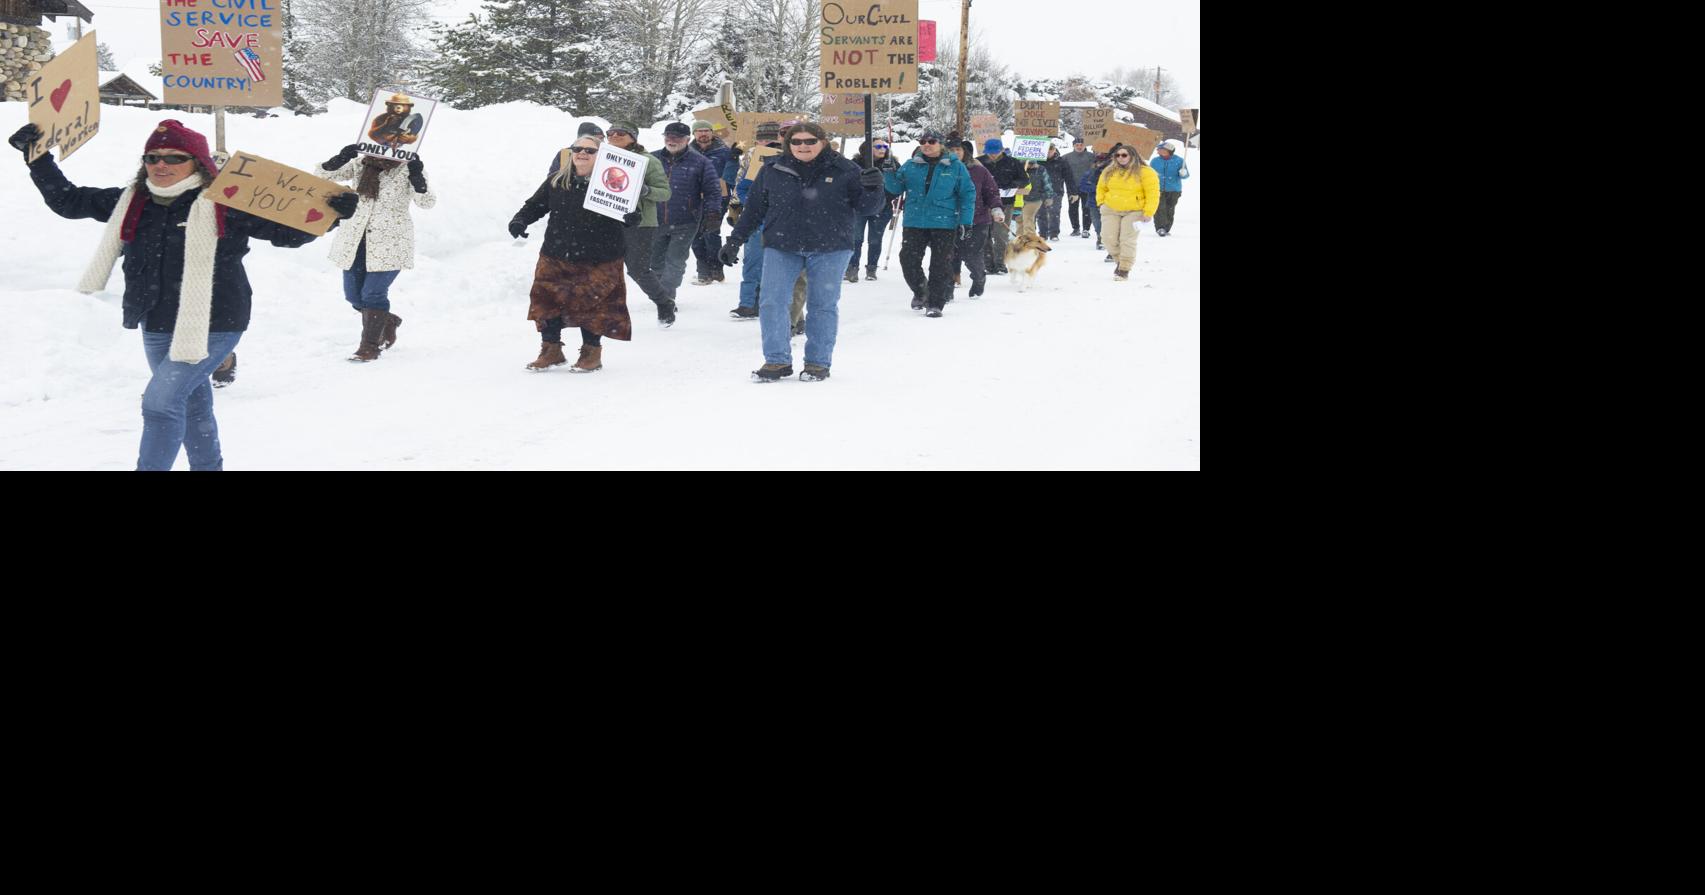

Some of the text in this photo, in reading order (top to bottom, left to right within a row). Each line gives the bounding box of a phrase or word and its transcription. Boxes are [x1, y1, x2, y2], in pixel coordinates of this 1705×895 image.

[166, 11, 272, 27] SERVICE
[192, 28, 260, 48] SAVE
[821, 26, 886, 45] SERVANTS
[889, 36, 913, 45] ARE
[168, 53, 213, 66] THE
[833, 49, 914, 65] NOT THE
[163, 74, 252, 92] COUNTRY!
[824, 71, 892, 88] PROBLEM
[31, 76, 44, 107] I
[1086, 109, 1112, 118] STOP
[359, 142, 390, 155] ONLY
[230, 156, 256, 178] I
[606, 153, 636, 168] ONLY YOU
[248, 185, 296, 212] YOU
[590, 195, 629, 213] FASCIST LIARS
[593, 188, 629, 205] CAN PREVENT
